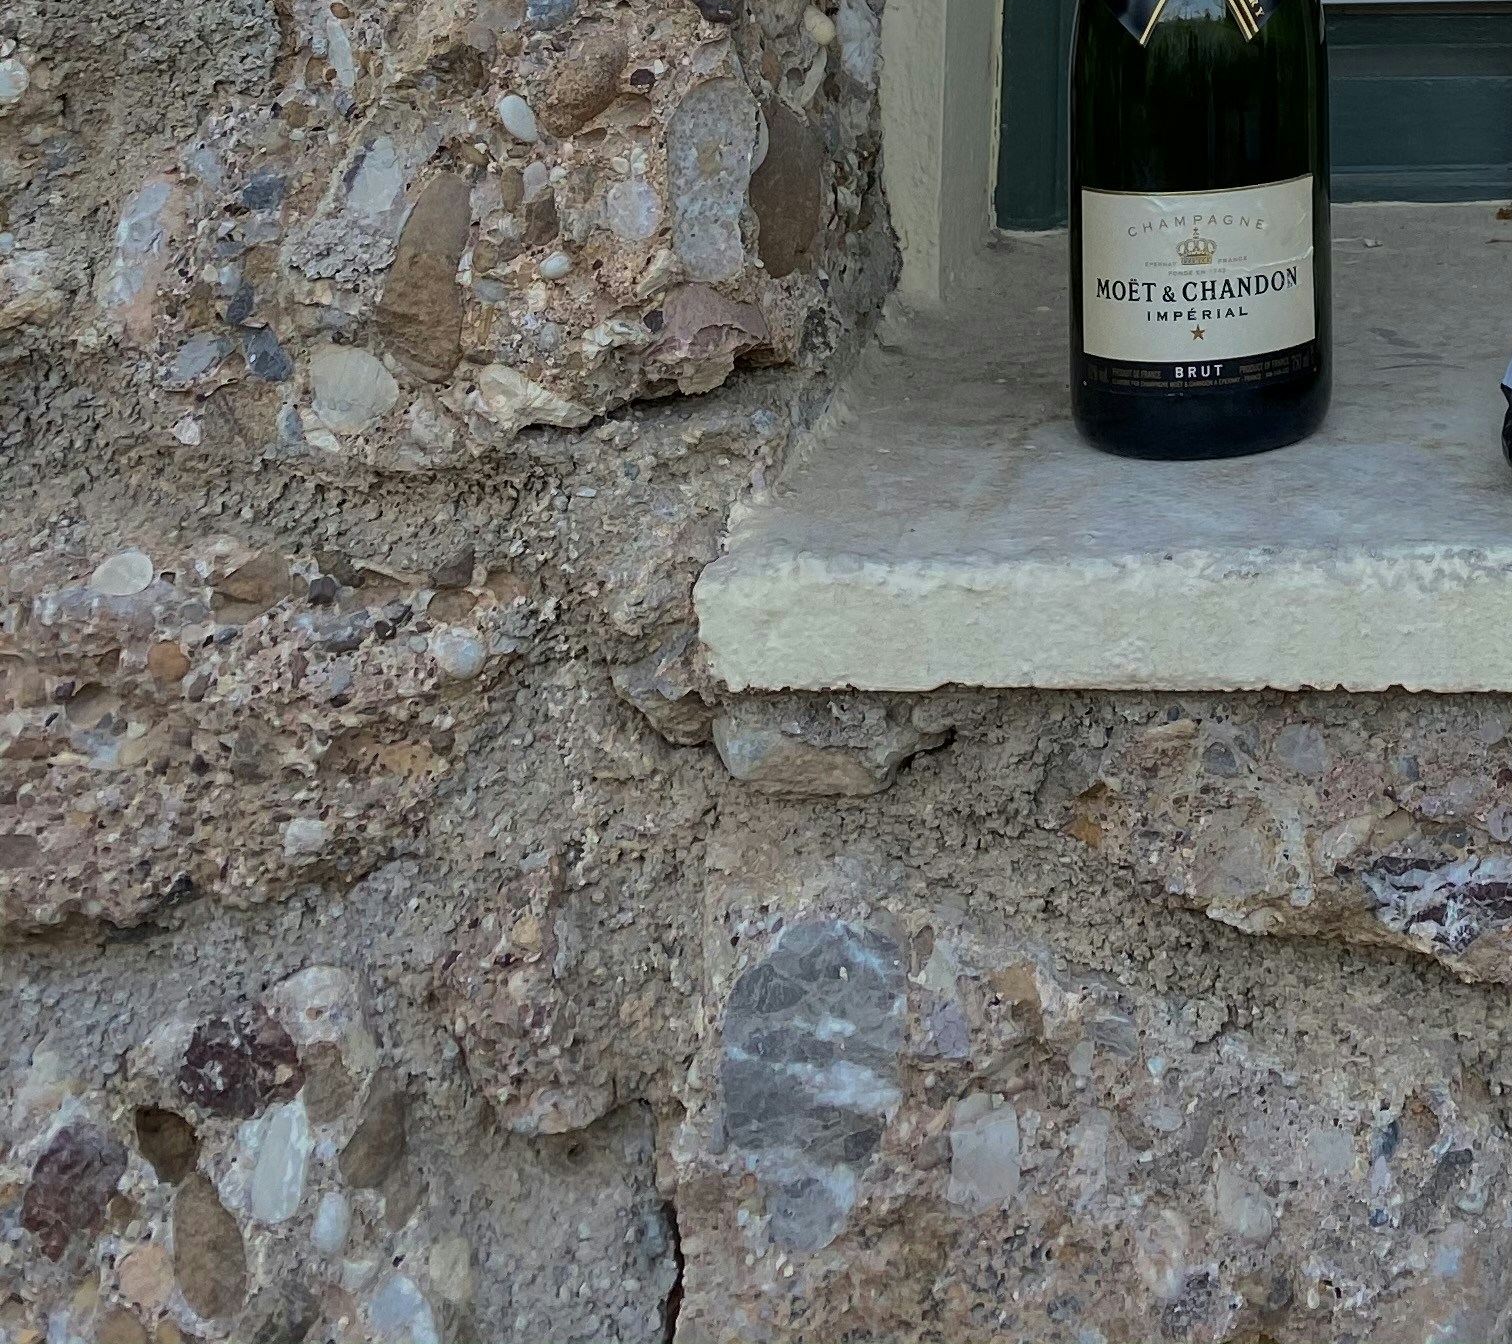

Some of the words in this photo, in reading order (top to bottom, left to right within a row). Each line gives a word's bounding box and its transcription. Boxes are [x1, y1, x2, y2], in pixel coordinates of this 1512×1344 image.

[1127, 214, 1266, 238] CHAMPAGNE
[1096, 277, 1157, 303] MOËT
[1161, 285, 1177, 303] &
[1181, 265, 1298, 303] CHANDON
[1146, 305, 1249, 322] IMPÉRIAL
[1174, 363, 1224, 379] BRUT
